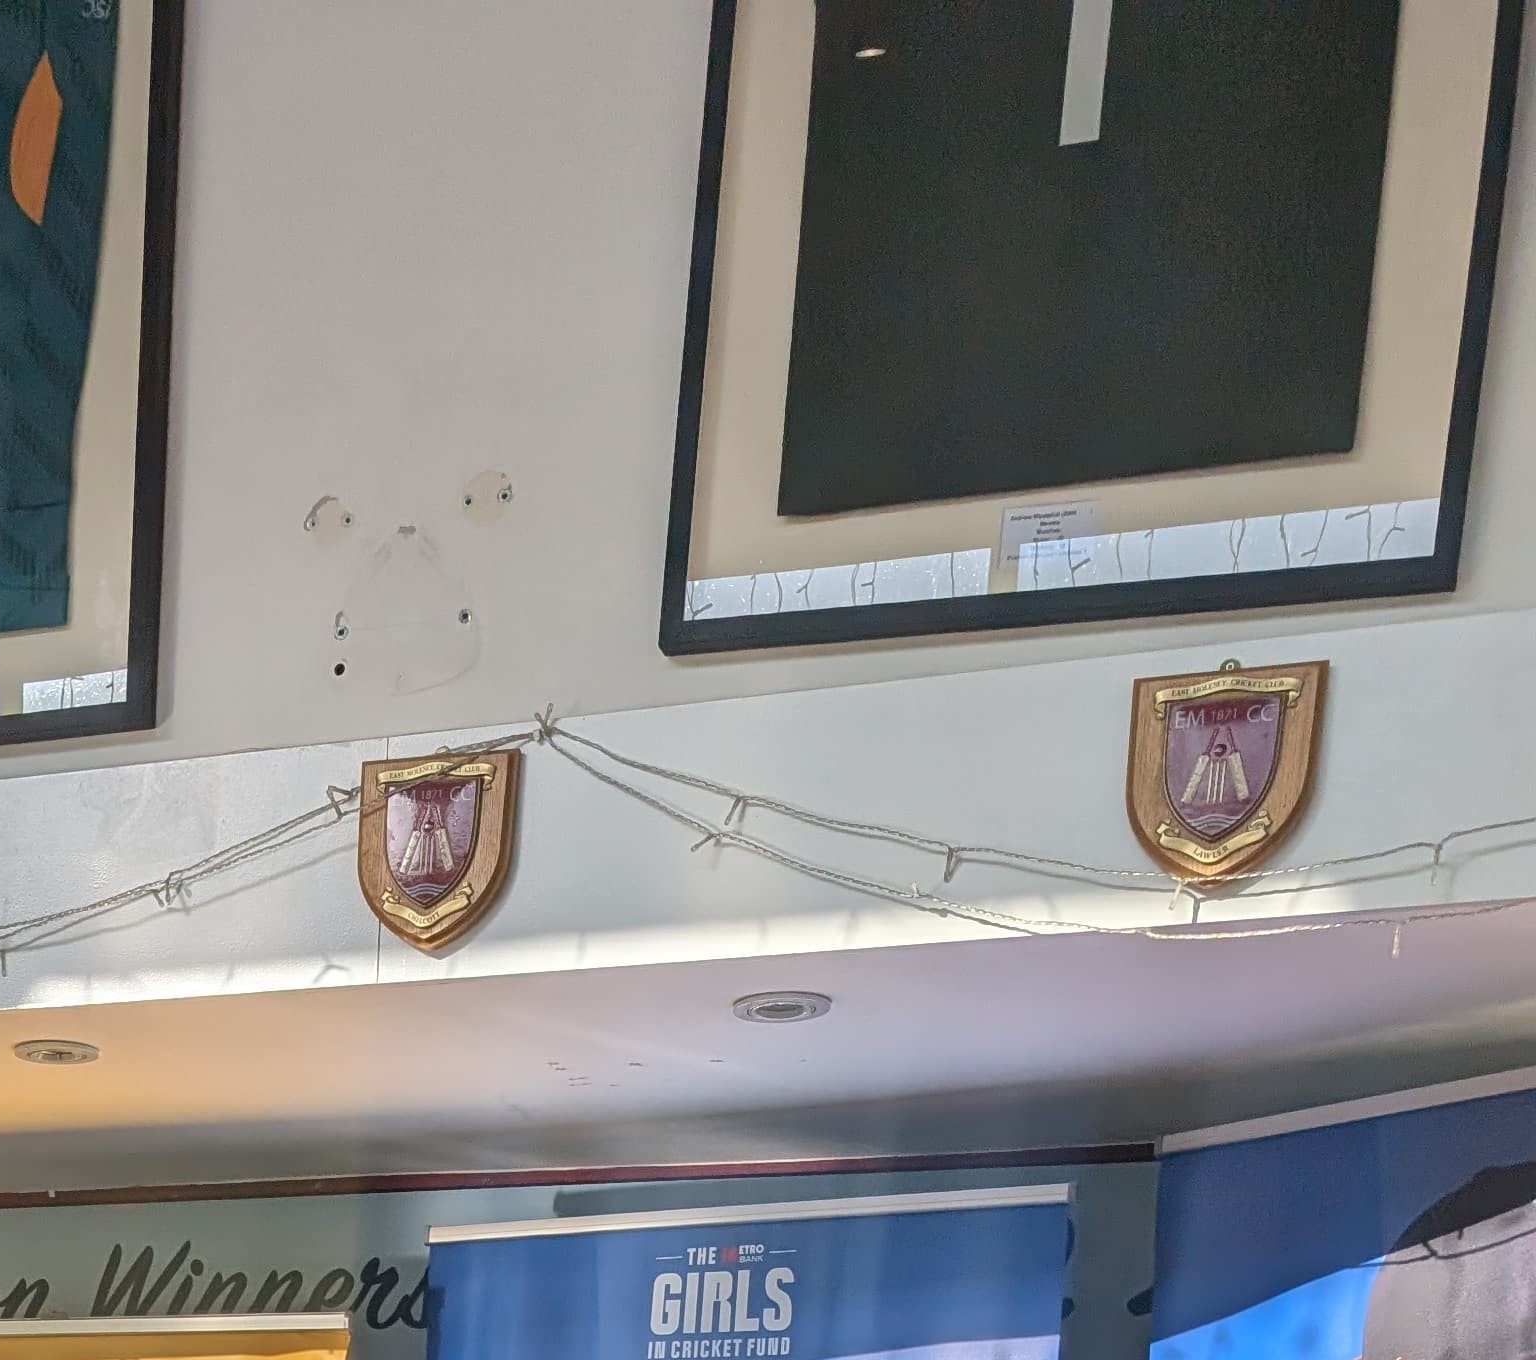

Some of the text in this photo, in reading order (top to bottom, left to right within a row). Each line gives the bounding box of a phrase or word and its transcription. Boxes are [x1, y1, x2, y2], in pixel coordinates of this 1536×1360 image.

[1175, 708, 1205, 729] EM
[1246, 703, 1278, 723] CC
[449, 786, 472, 802] CC
[686, 1246, 717, 1266] THE
[650, 1266, 796, 1336] GIRLS
[647, 1336, 791, 1360] IN CRICKET FUND
